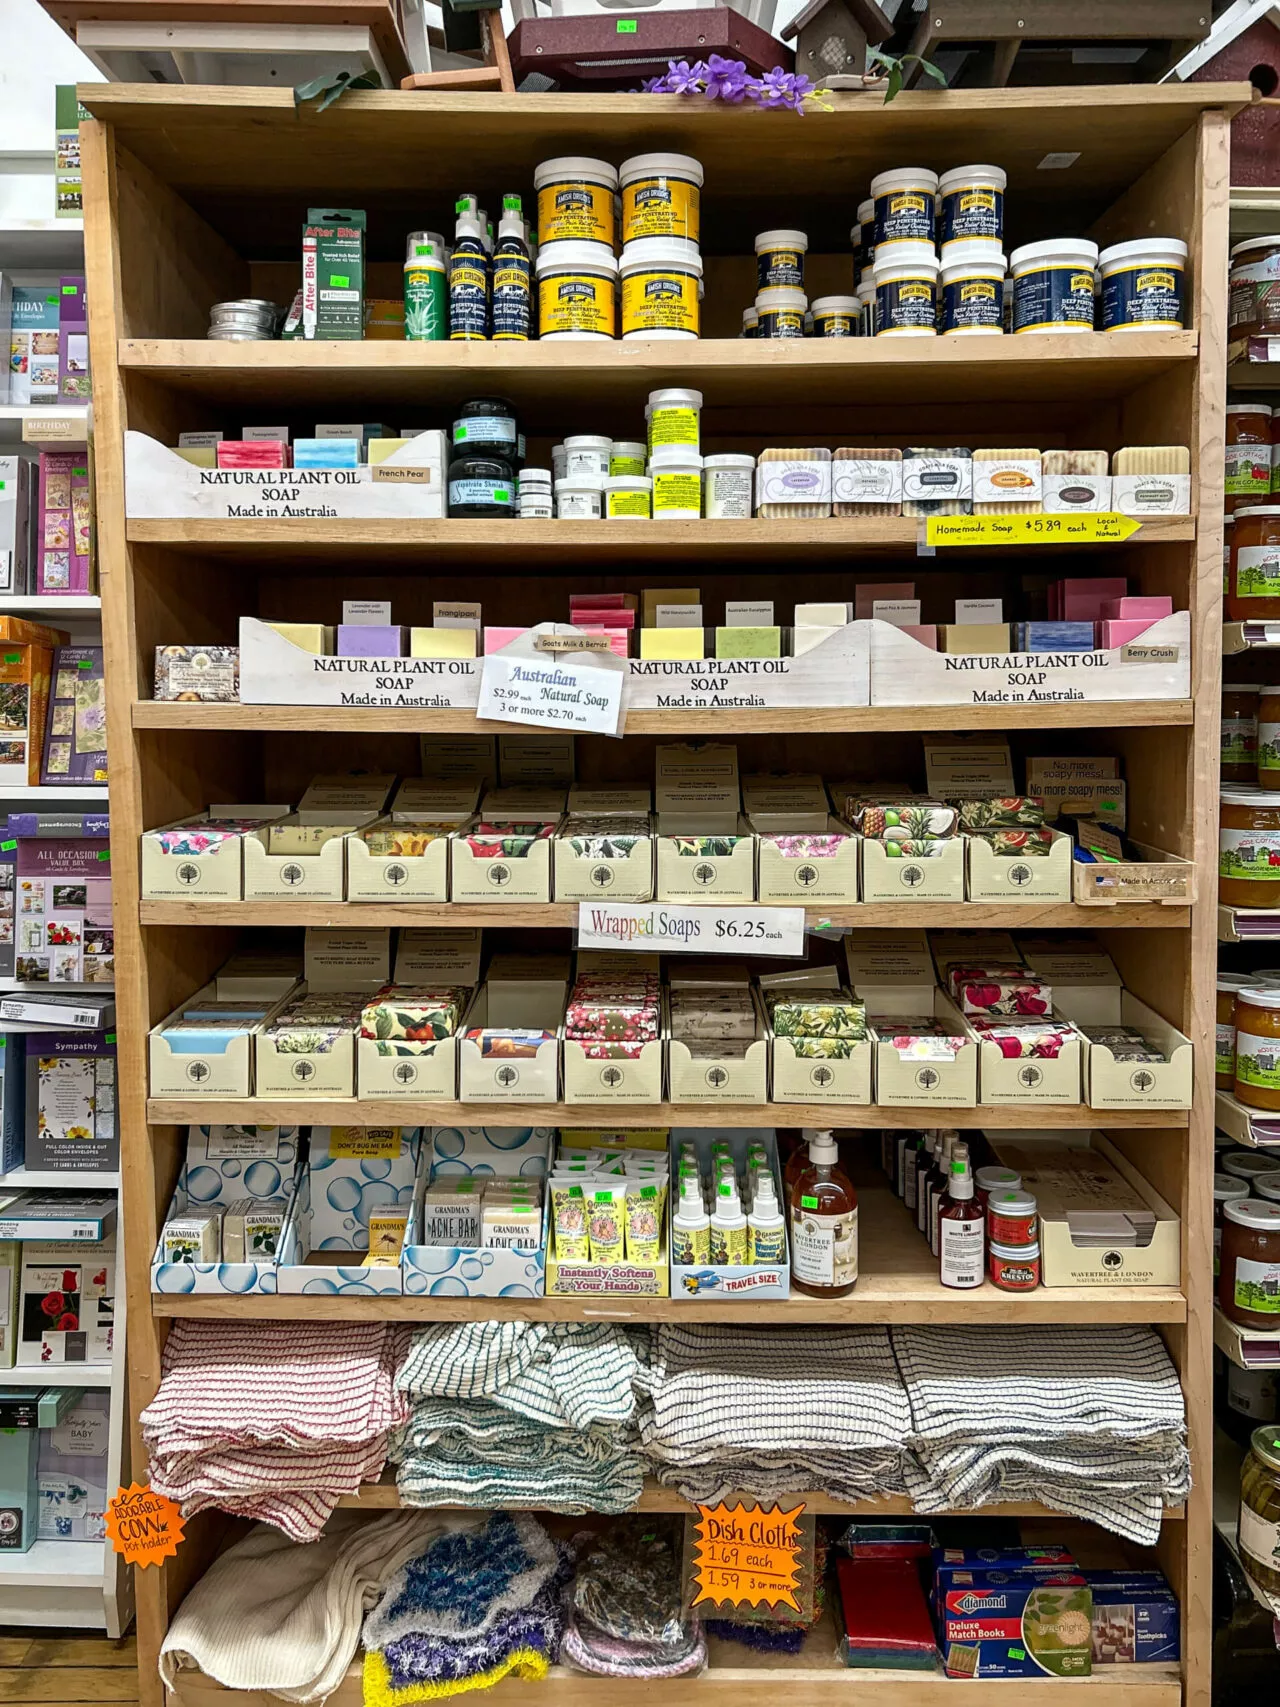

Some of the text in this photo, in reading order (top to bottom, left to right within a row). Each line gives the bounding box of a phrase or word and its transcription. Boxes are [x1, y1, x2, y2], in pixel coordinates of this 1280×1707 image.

[305, 227, 360, 237] After Bite
[305, 256, 314, 311] After Bite
[200, 472, 361, 484] NATURAL PLANT OIL
[379, 469, 424, 479] French Pear
[261, 489, 300, 501] SOAP
[227, 505, 338, 517] Made in Australia
[936, 524, 985, 534] Homemade
[992, 525, 1013, 533] Soap
[1067, 523, 1087, 532] each
[438, 609, 477, 618] Frangipani
[542, 640, 561, 648] Goats
[562, 639, 576, 648] Milk
[585, 640, 607, 649] Berries
[1127, 648, 1174, 658] Berry Crush
[313, 659, 475, 674] NATURAL PLANT OIL
[629, 661, 789, 674] NATURAL PLANT OIL
[945, 654, 1109, 671] NATURAL PLANT OIL
[509, 666, 577, 687] Australian
[1007, 672, 1046, 686] SOAP
[375, 677, 414, 690] SOAP
[691, 678, 728, 691] SOAP
[341, 693, 451, 706] Made in Australia
[493, 688, 520, 700] $2.99
[540, 687, 580, 704] Natural
[584, 692, 609, 710] Soap
[657, 695, 765, 707] Made in Australia
[973, 688, 1085, 703] Made in Australia
[500, 702, 506, 712] 3
[508, 705, 519, 714] or
[521, 706, 545, 716] more
[547, 708, 574, 720] $2.70
[1052, 761, 1095, 770] No more
[1030, 784, 1123, 798] No more soapy mess!
[38, 851, 98, 859] ALL OCCASION
[591, 910, 654, 941] Wrapped
[659, 912, 701, 942] Soaps
[55, 1043, 98, 1051] Sympathy
[247, 1217, 280, 1225] GRANDMA'S
[371, 1223, 404, 1231] GRANDMA'S
[431, 1218, 476, 1237] ACNE BAR
[166, 1230, 200, 1238] GRANDMA'S
[493, 1225, 530, 1234] GRANDMA'S
[560, 1268, 653, 1279] Instantly Softens
[1001, 1272, 1034, 1280] KRESTOL
[574, 1281, 640, 1291] Your Hands
[726, 1275, 777, 1291] TRAVEL SIZE
[71, 1430, 92, 1438] BABY
[115, 1498, 164, 1520] ADORABLE
[118, 1514, 161, 1541] COW
[707, 1519, 798, 1548] Dish Cloths
[124, 1536, 171, 1552] pot holder
[708, 1546, 773, 1568] 1.69 each
[708, 1571, 739, 1590] 1.59
[750, 1578, 755, 1589] 3
[769, 1582, 792, 1591] more
[964, 1595, 1006, 1609] diamond
[949, 1622, 980, 1630] Deluxe
[1040, 1622, 1083, 1636] greenlight
[949, 1629, 1005, 1639] Match Books
